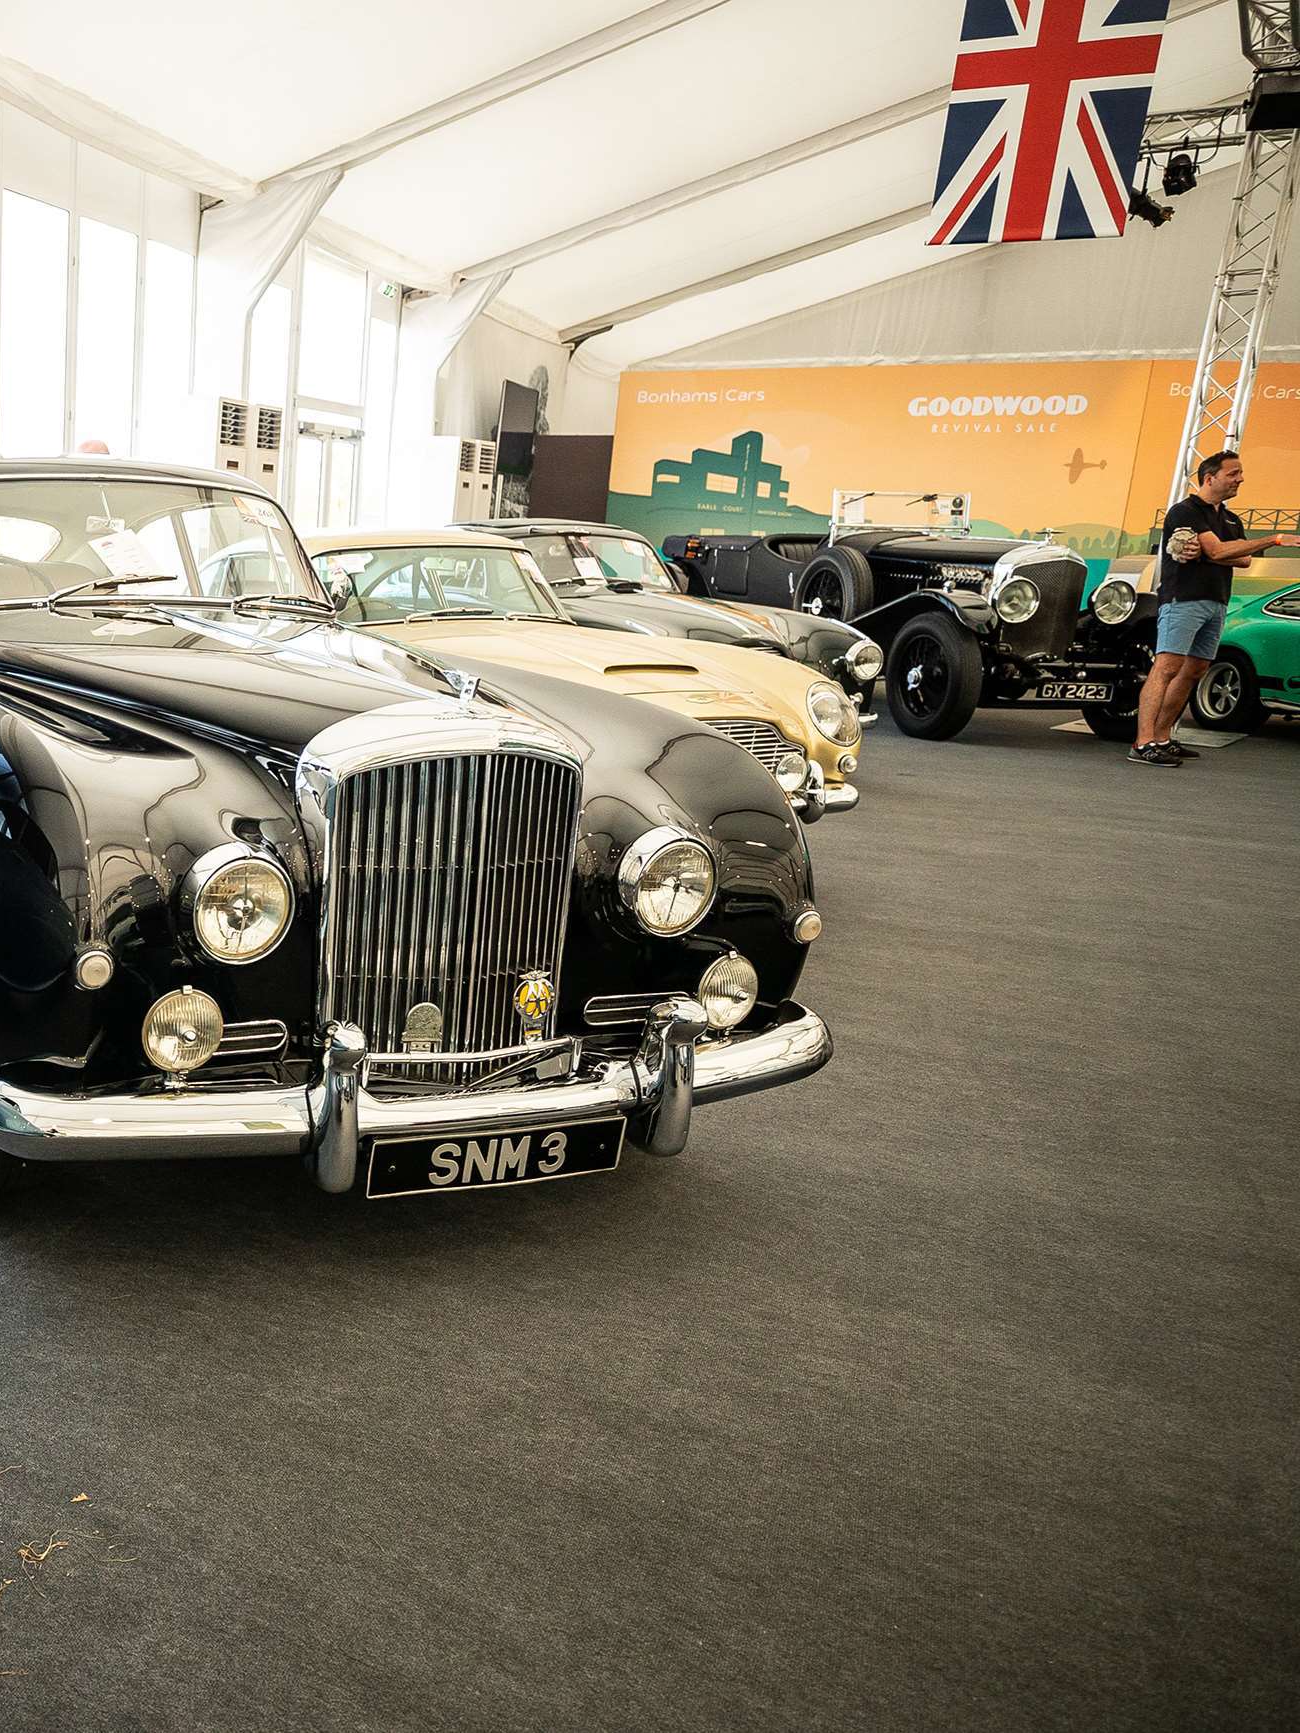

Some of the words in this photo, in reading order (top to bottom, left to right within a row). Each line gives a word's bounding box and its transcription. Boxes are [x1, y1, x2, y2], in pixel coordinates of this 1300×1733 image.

[636, 388, 717, 403] Bonhams
[725, 388, 765, 402] Cars
[907, 395, 1088, 416] GOODWOOD
[931, 423, 1002, 433] REVIVAL
[1015, 422, 1059, 433] SALE
[1042, 684, 1063, 698] GX
[1065, 685, 1107, 699] 2423
[428, 1135, 531, 1185] SNM
[538, 1131, 568, 1174] 3
